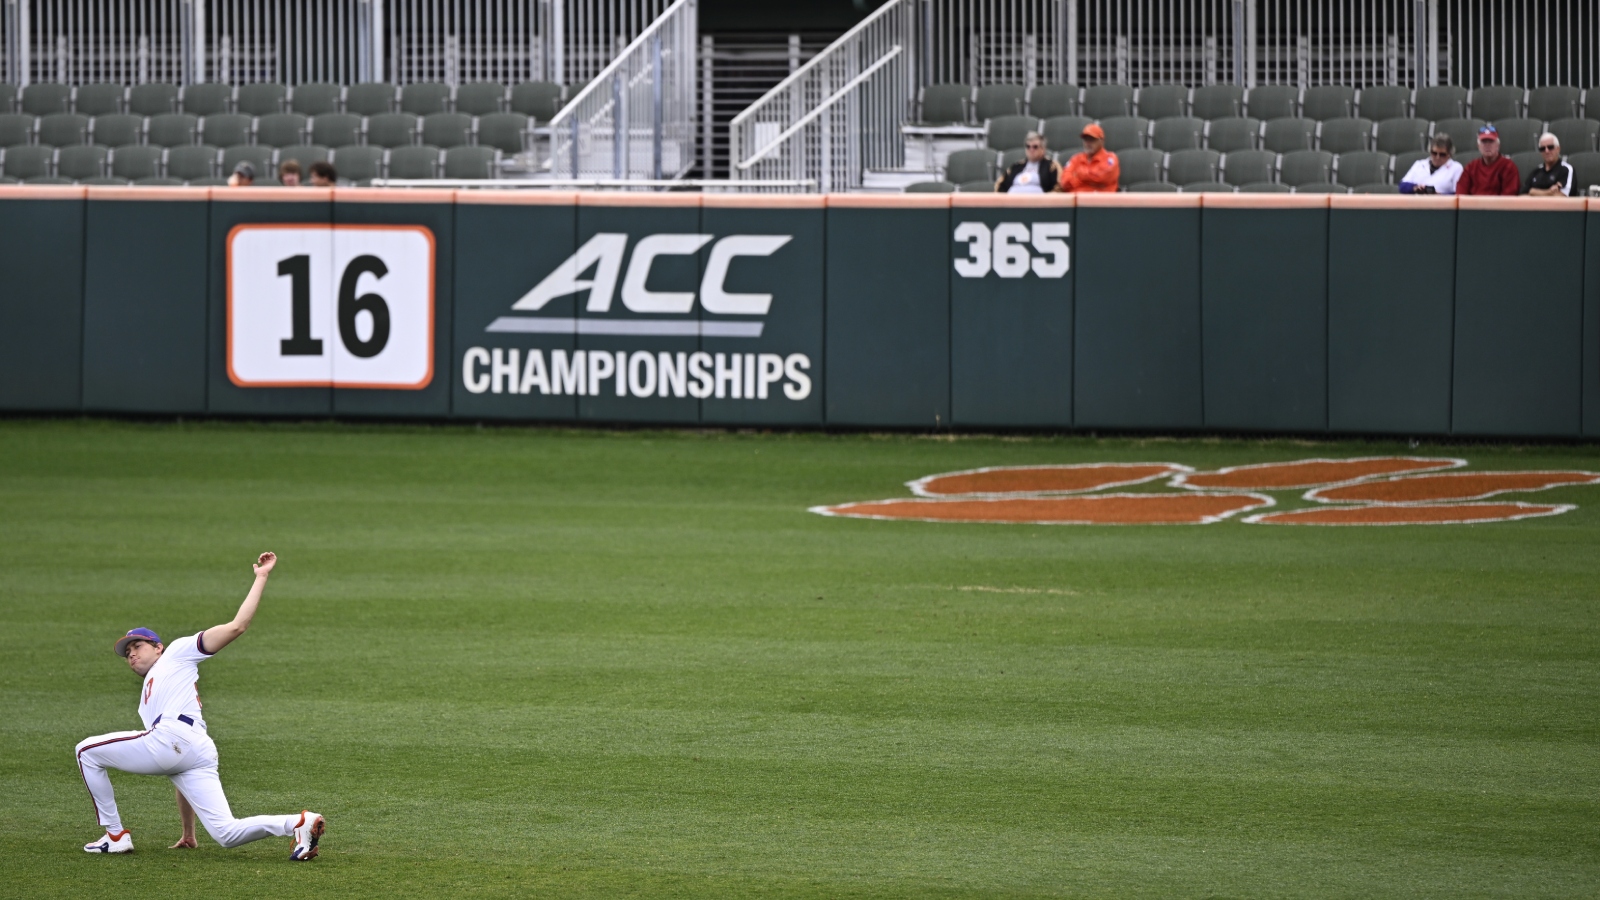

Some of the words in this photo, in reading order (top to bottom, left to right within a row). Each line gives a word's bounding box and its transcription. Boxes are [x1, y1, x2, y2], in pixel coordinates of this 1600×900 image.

[511, 232, 794, 315] ACC
[953, 221, 1070, 279] 365
[277, 253, 391, 359] 16
[462, 346, 812, 401] CHAMPIONSHIPS
